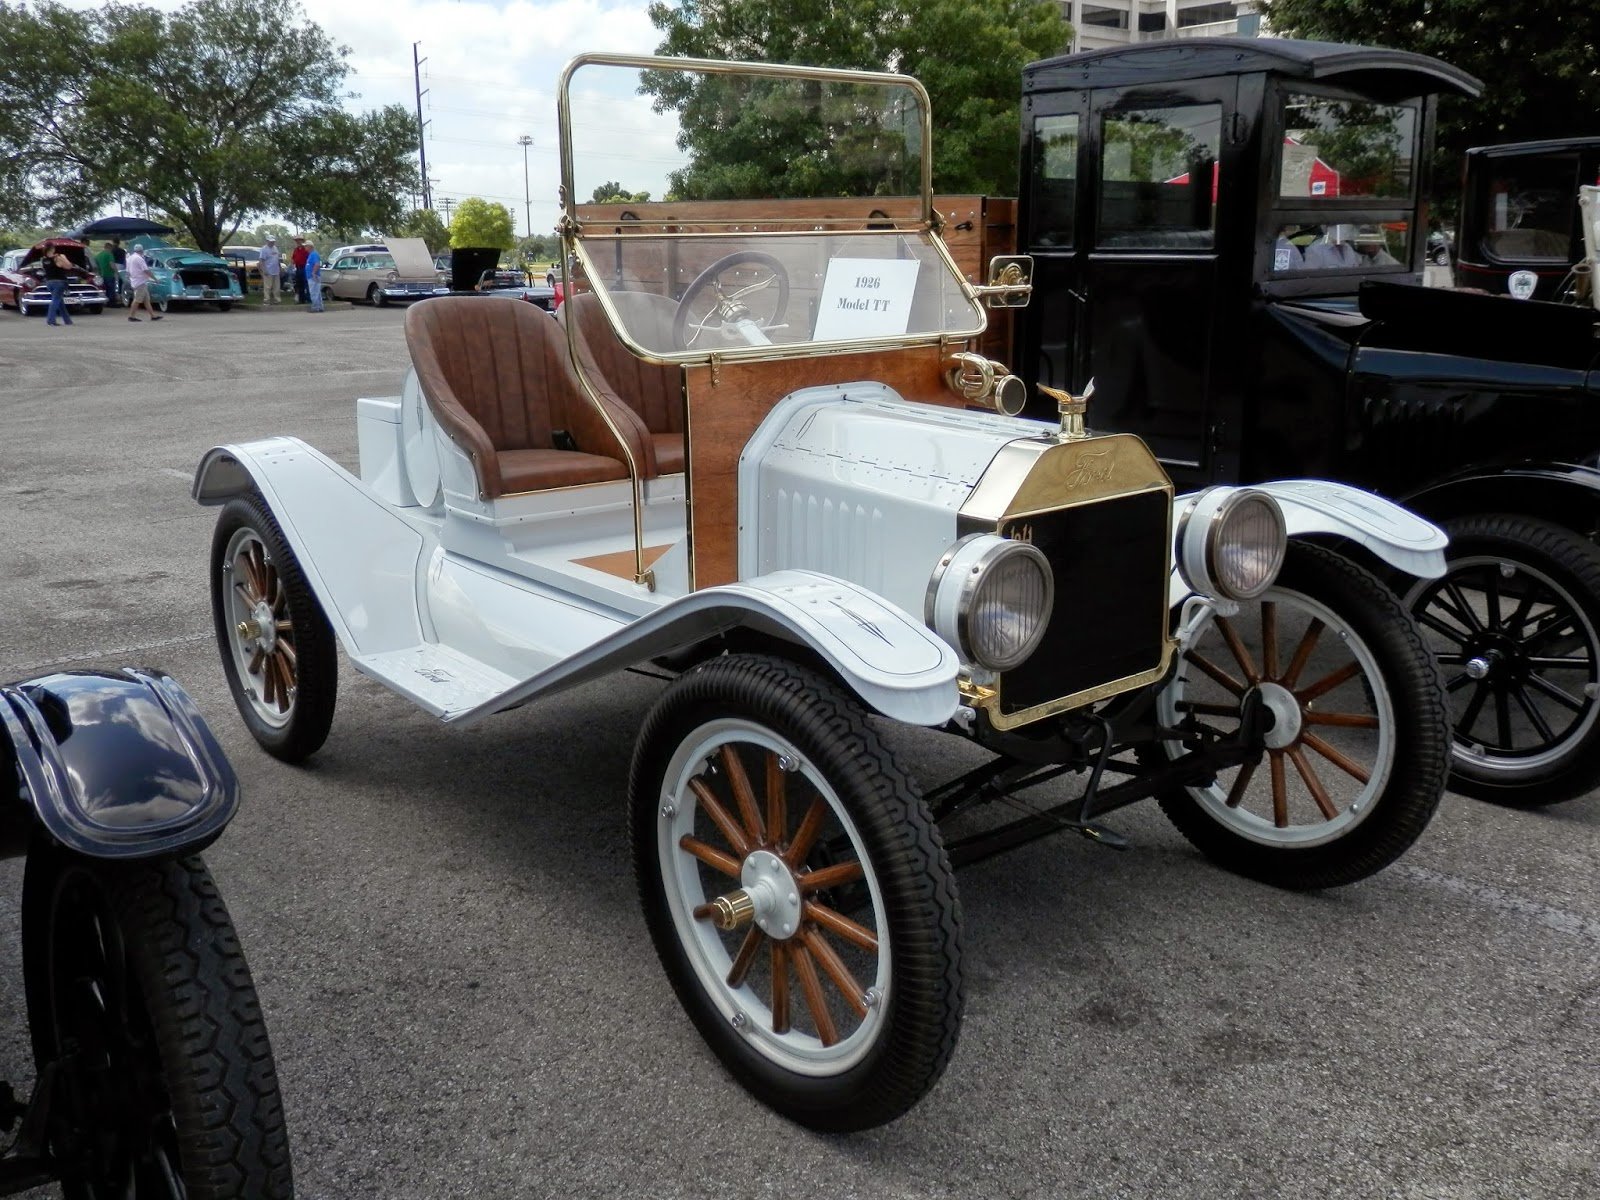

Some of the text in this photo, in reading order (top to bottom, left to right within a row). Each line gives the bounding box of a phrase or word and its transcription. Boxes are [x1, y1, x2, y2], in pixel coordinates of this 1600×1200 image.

[855, 276, 881, 289] 1926
[837, 297, 891, 312] Model TT
[1065, 449, 1115, 489] Ford
